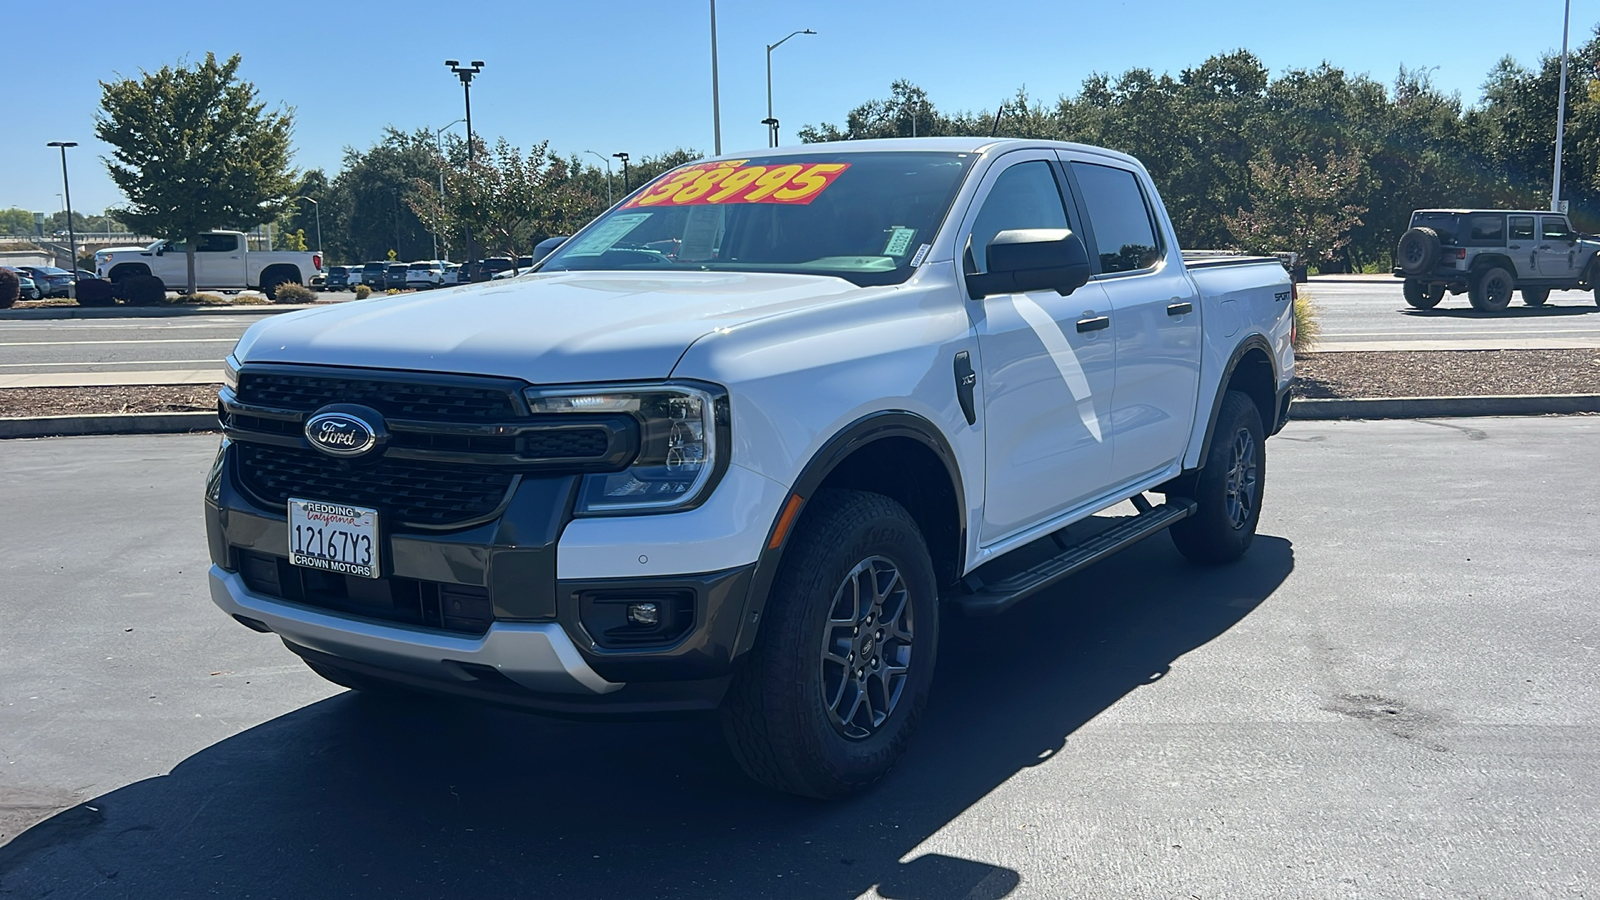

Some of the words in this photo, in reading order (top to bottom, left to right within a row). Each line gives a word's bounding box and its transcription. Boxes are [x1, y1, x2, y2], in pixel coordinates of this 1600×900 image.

[1274, 291, 1291, 302] SPORT
[318, 420, 356, 446] Ford
[306, 510, 361, 527] California
[307, 502, 354, 517] REDDING
[295, 524, 372, 566] 12167Y3
[295, 555, 329, 570] CROWN
[331, 561, 371, 577] MOTORS
